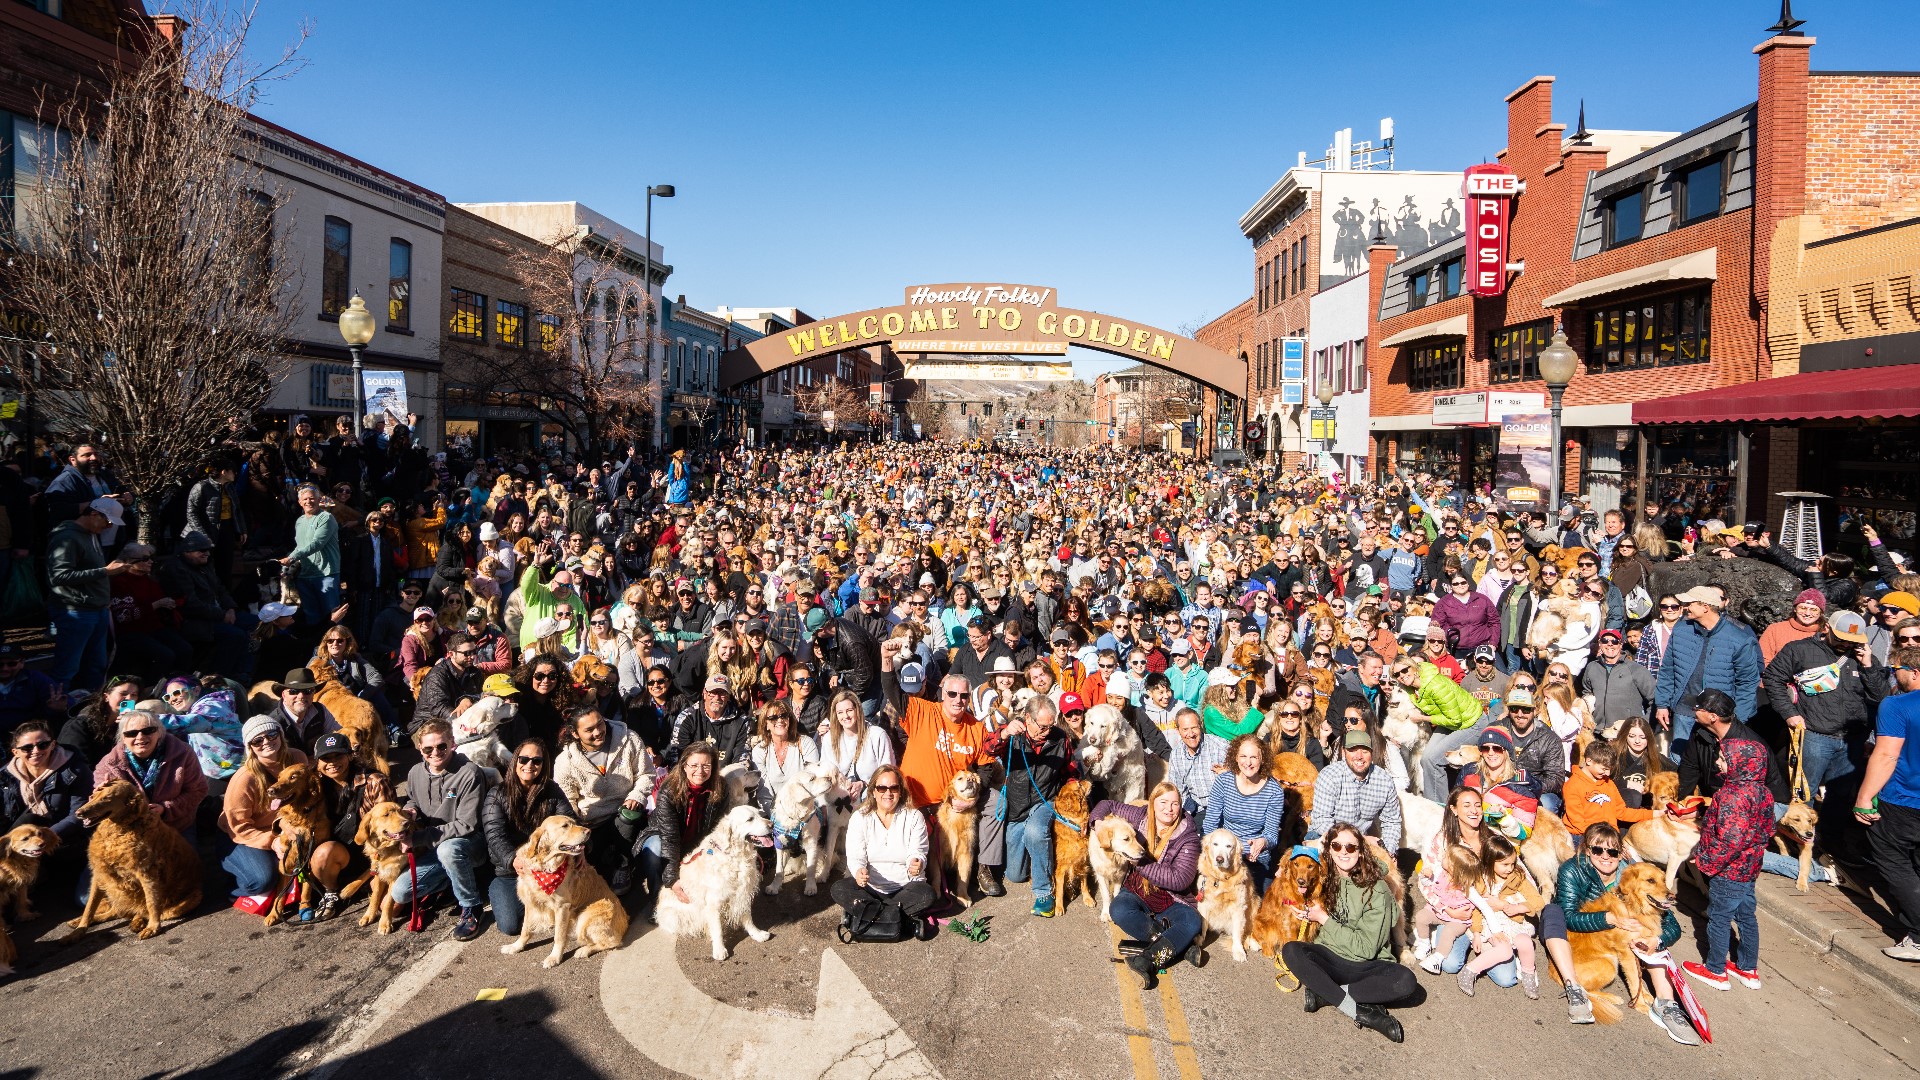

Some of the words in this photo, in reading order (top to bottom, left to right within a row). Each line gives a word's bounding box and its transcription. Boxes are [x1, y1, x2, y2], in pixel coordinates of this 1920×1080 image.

[1473, 179, 1514, 190] THE
[1479, 199, 1499, 287] ROSE
[910, 287, 981, 306] Howdy
[984, 286, 1051, 307] Folks!
[786, 307, 959, 355] WELCOME
[971, 306, 1023, 330] TO
[1037, 311, 1176, 361] GOLDEN
[898, 341, 947, 351] WHERE
[952, 342, 976, 351] THE
[981, 341, 1020, 351] WEST
[1023, 342, 1062, 352] LIVES
[365, 378, 402, 386] GOLDEN
[1505, 424, 1548, 432] GOLDEN
